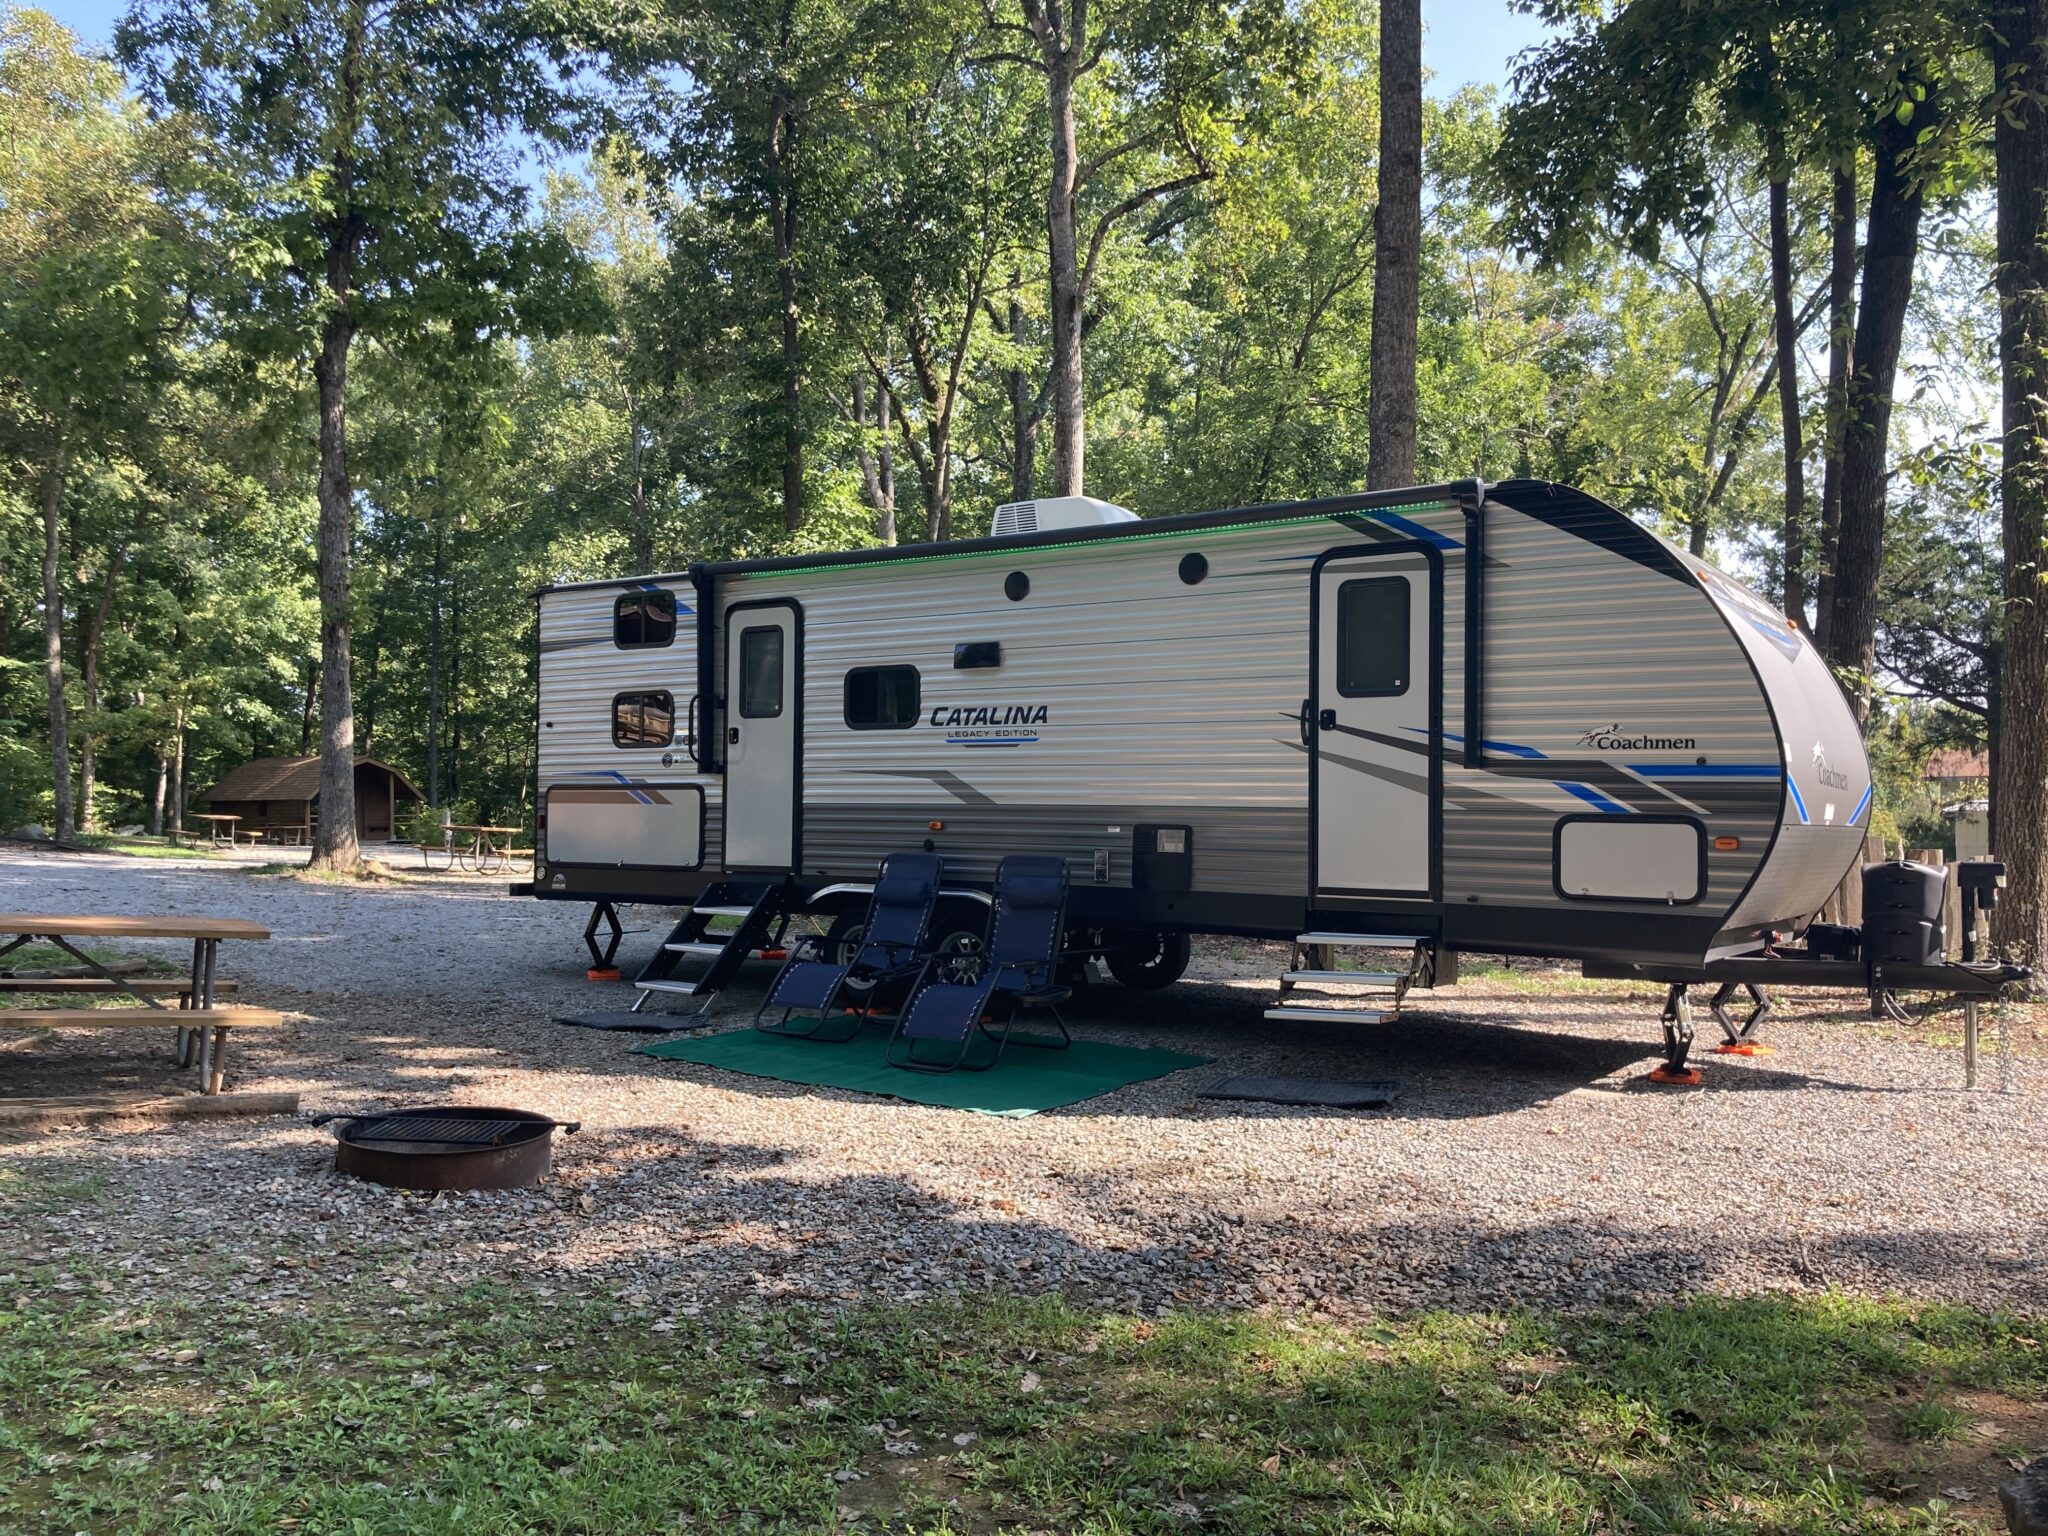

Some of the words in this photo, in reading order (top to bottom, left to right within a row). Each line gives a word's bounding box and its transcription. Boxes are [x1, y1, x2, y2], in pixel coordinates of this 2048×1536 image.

[930, 705, 1048, 727] CATALINA
[947, 730, 990, 738] LEGACY
[995, 729, 1038, 737] EDITION
[1597, 735, 1696, 750] Coachmen
[1818, 763, 1848, 791] Coachmen
